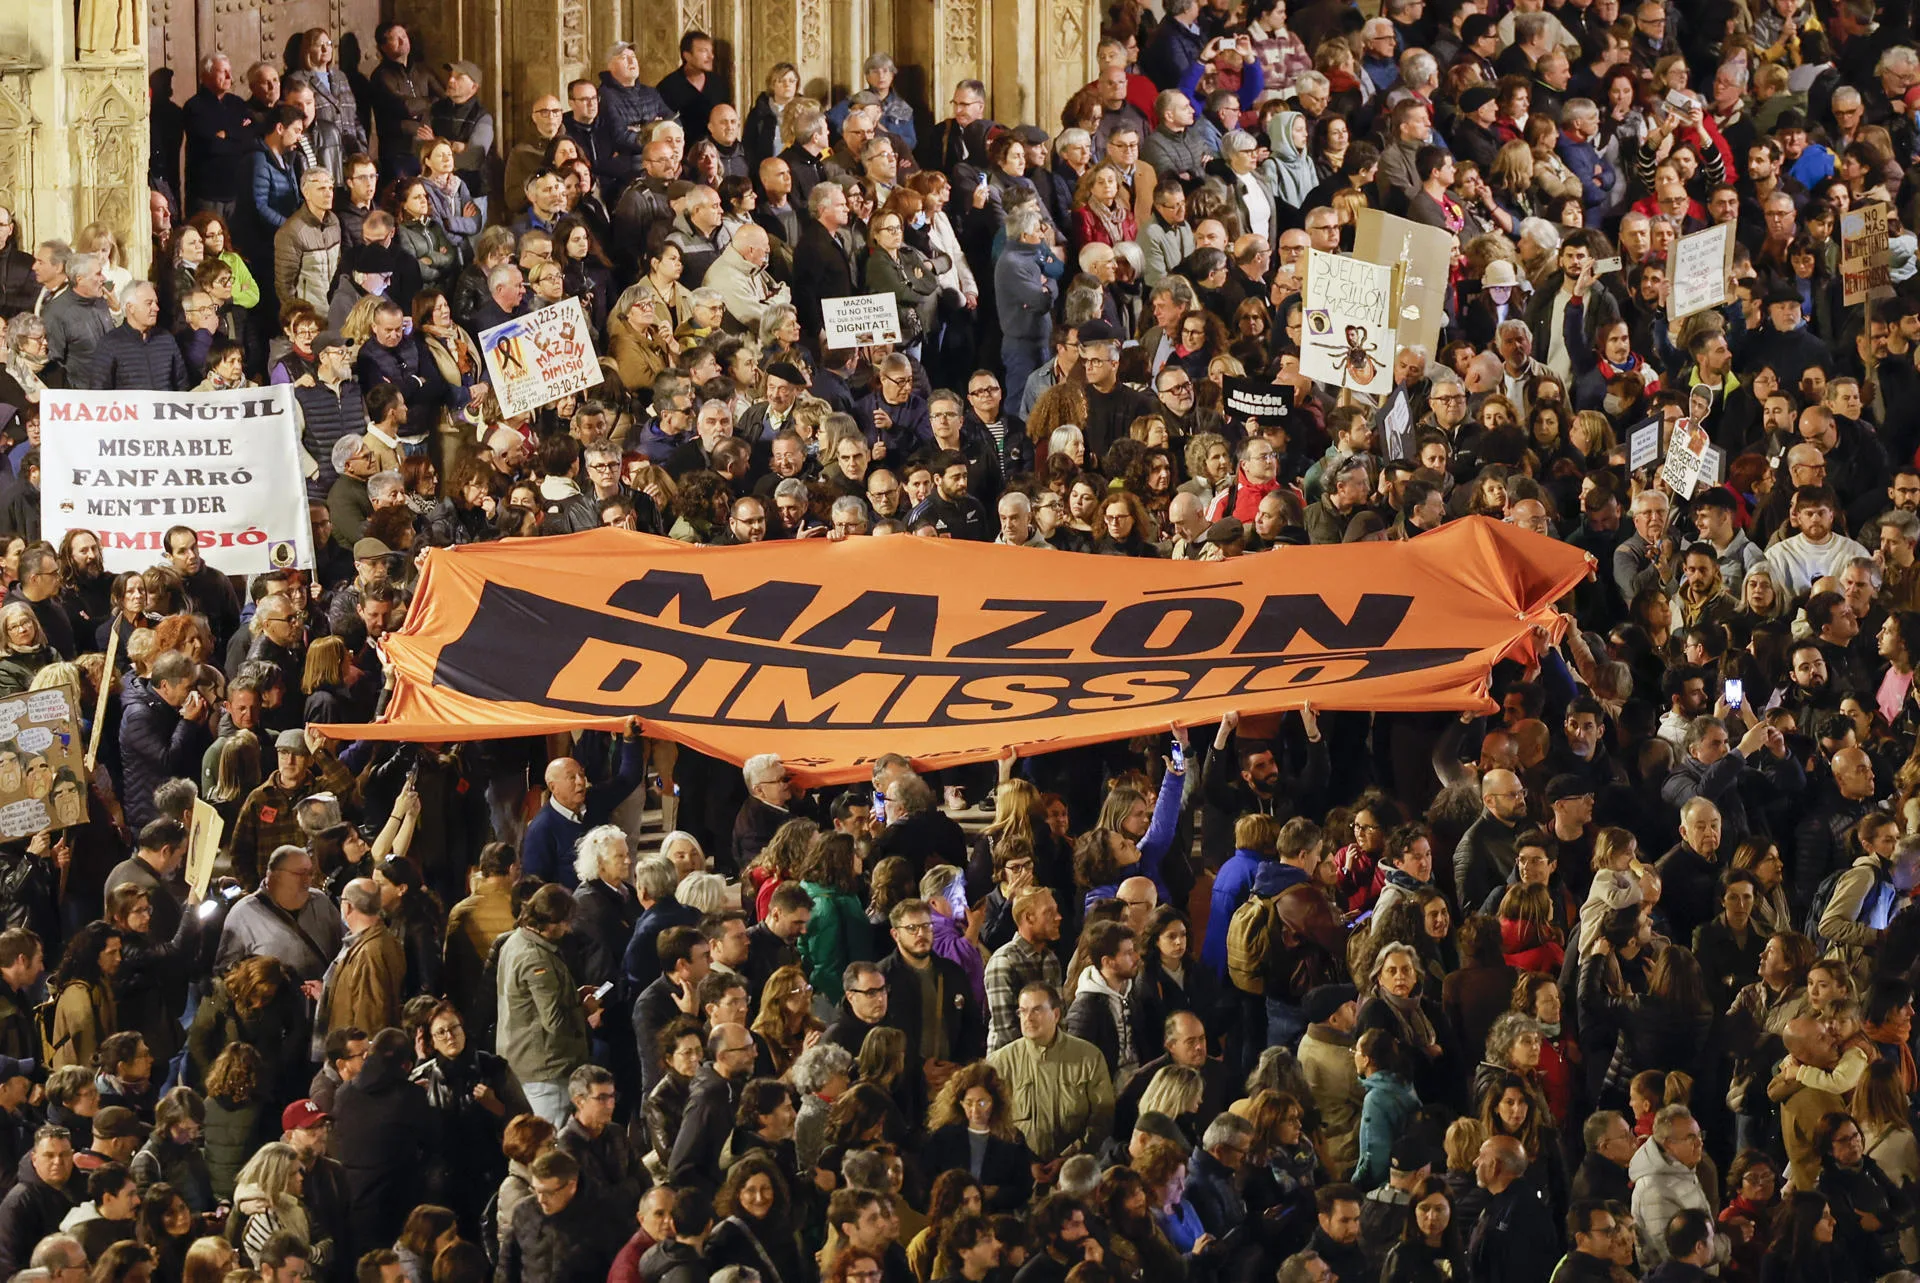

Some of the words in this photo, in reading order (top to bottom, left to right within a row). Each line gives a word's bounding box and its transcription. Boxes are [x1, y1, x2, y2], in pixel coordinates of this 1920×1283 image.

[1864, 209, 1878, 222] NO
[1317, 254, 1376, 289] SUELTA
[1313, 277, 1334, 298] EL
[538, 306, 558, 324] 225
[837, 309, 847, 317] TU
[849, 307, 861, 316] NO
[863, 305, 885, 314] TENS
[836, 320, 889, 333] DIGNITAT!
[548, 372, 588, 398] 29-10-24
[1227, 397, 1288, 416] DIMISSIÓ
[1232, 389, 1282, 406] MAZÓN
[49, 401, 140, 422] MAZÓN
[152, 399, 286, 420] INÚTIL
[98, 438, 234, 457] MISERABLE
[1669, 440, 1701, 472] BOMBEROS
[72, 467, 253, 487] FANFARRÓ
[605, 568, 1415, 658] MAZÓN
[545, 637, 1371, 724] DIMISSIÓ
